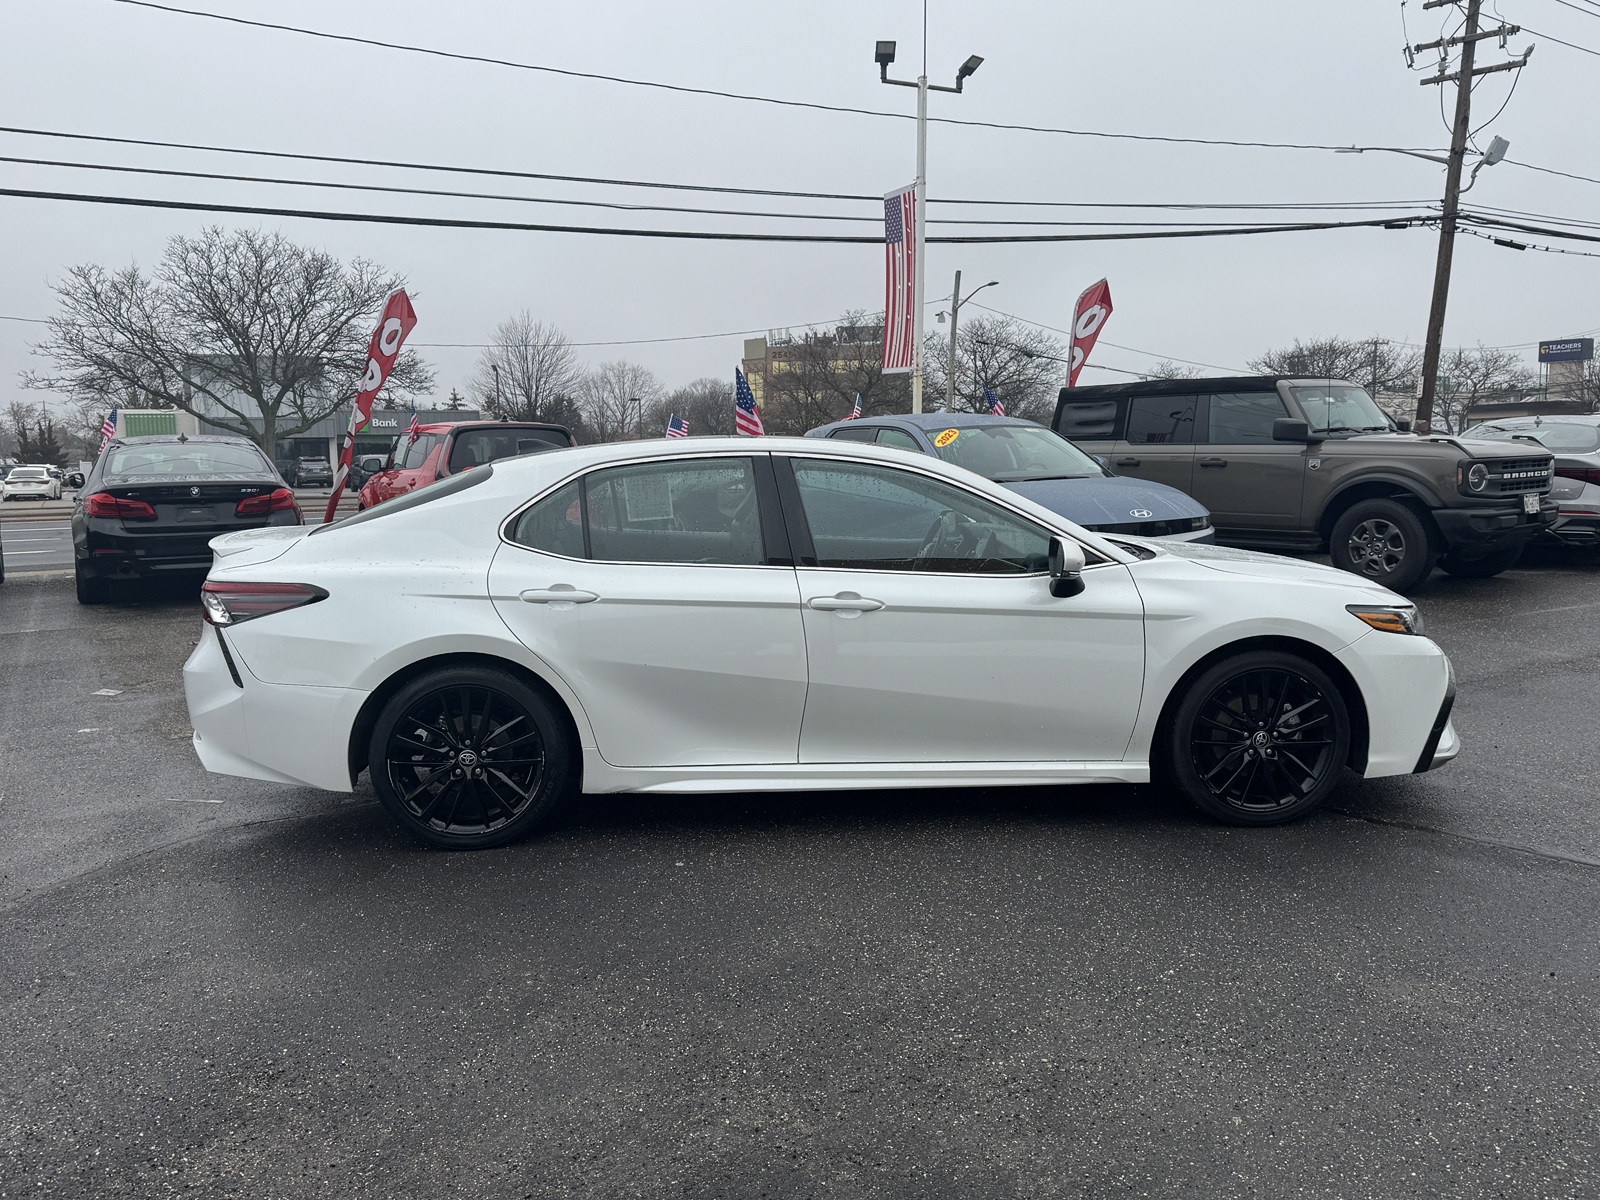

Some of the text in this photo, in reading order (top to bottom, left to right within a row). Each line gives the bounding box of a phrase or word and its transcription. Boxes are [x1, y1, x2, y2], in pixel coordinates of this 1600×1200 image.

[1549, 342, 1582, 351] TEACHERS
[372, 418, 398, 427] Bank
[937, 429, 957, 446] 2023
[1503, 470, 1548, 479] BRONCO
